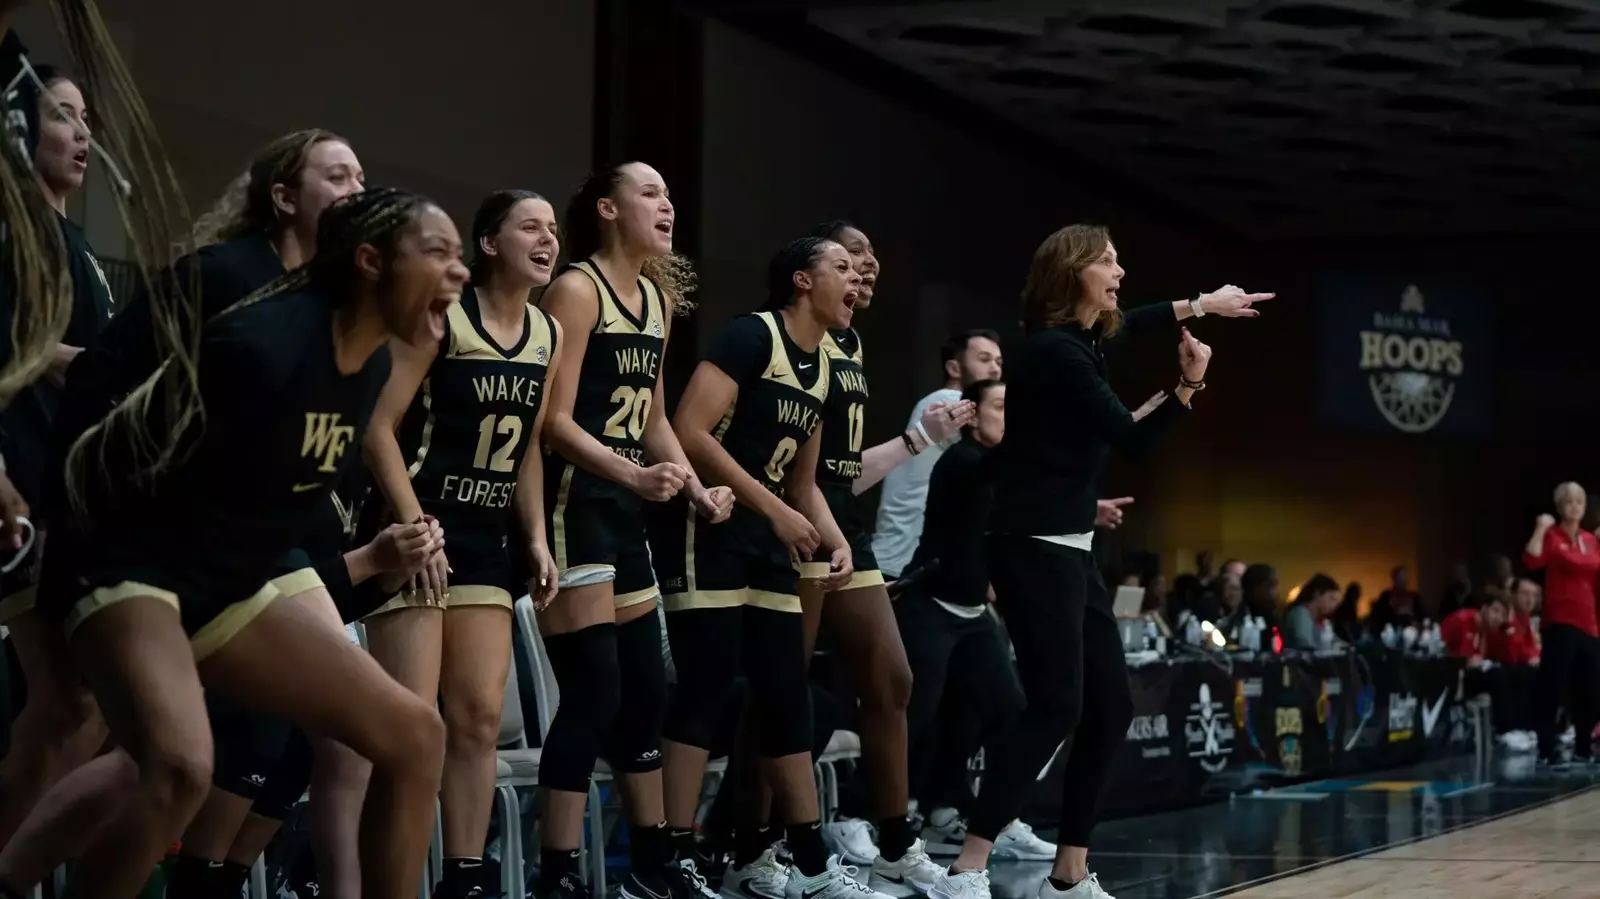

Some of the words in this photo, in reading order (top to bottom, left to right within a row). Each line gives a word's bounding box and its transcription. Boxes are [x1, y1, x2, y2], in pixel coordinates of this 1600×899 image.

[615, 347, 658, 379] WAKE
[1359, 330, 1464, 377] HOOPS
[472, 374, 539, 407] WAKE
[835, 370, 869, 398] WAK
[602, 385, 653, 441] 20
[777, 398, 820, 437] WAKE
[848, 402, 864, 453] 11
[300, 411, 355, 473] WF
[472, 413, 523, 473] 12
[764, 435, 798, 482] 0
[440, 475, 517, 508] FOREST
